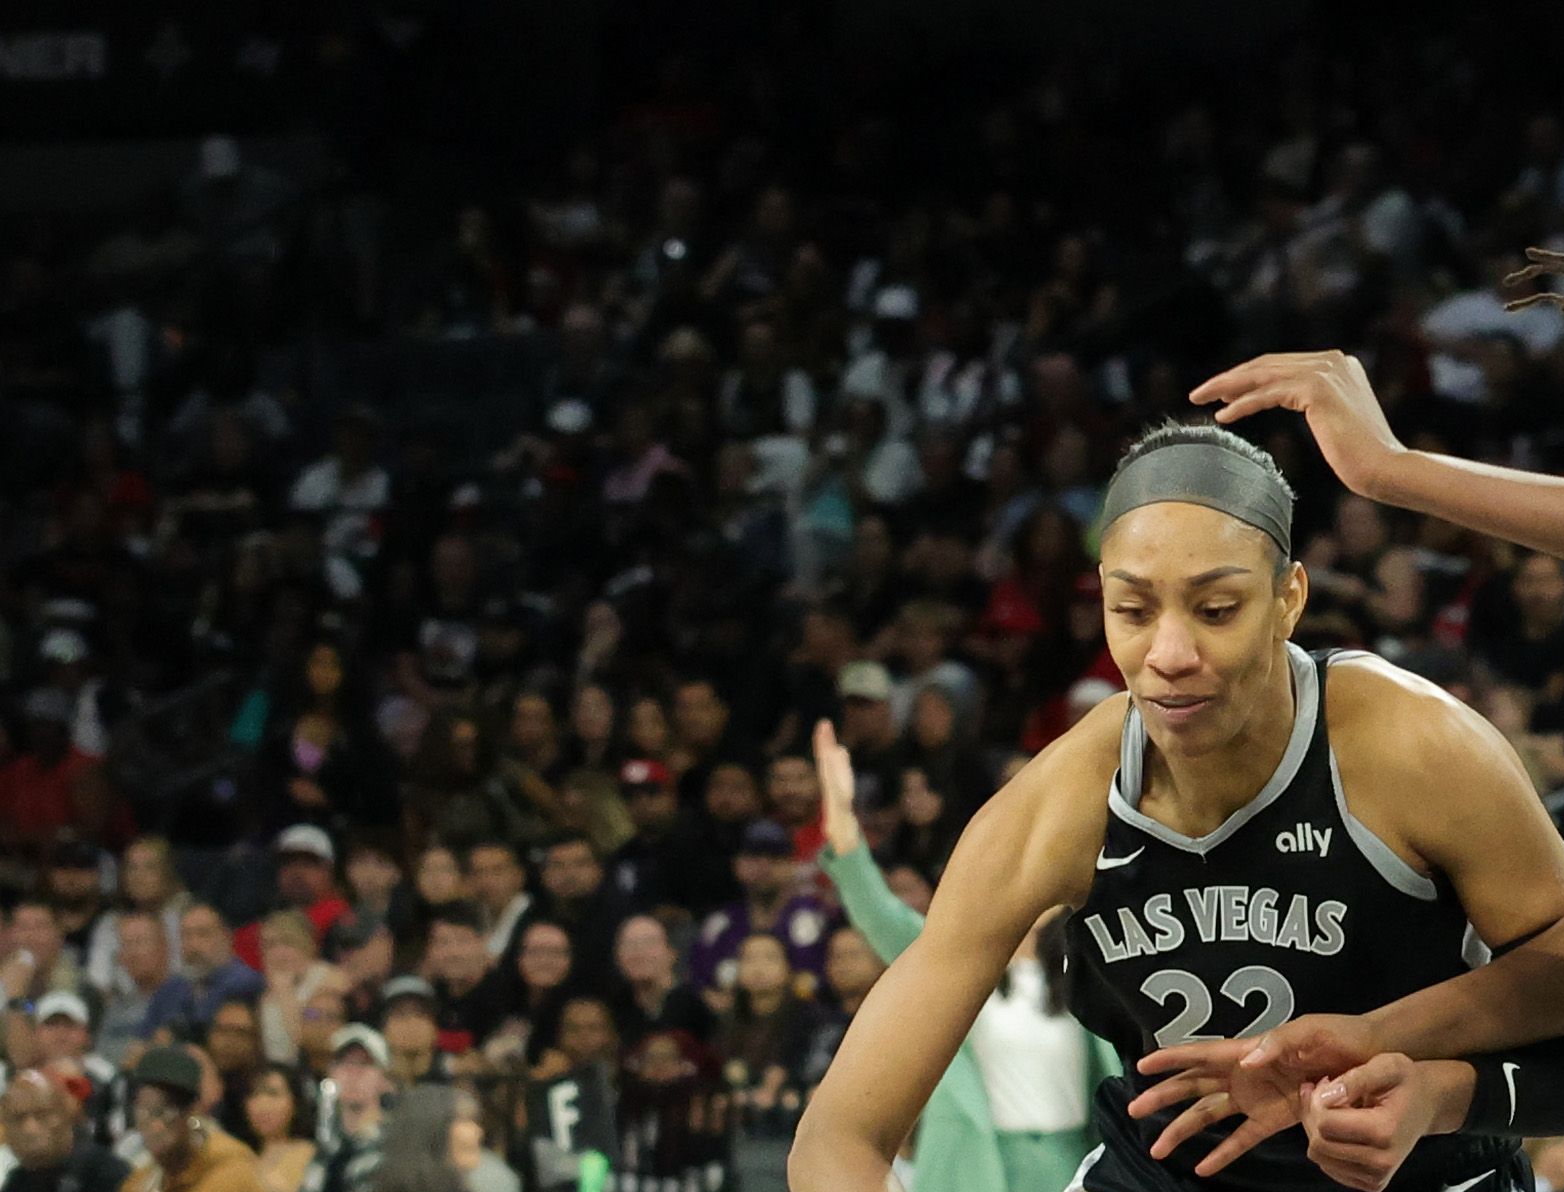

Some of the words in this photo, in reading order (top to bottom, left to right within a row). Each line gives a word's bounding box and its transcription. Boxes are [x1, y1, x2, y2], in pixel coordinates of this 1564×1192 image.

[1275, 822, 1333, 858] ally
[1084, 893, 1186, 964] LAS
[1184, 885, 1347, 957] VEGAS
[1140, 965, 1295, 1049] 22
